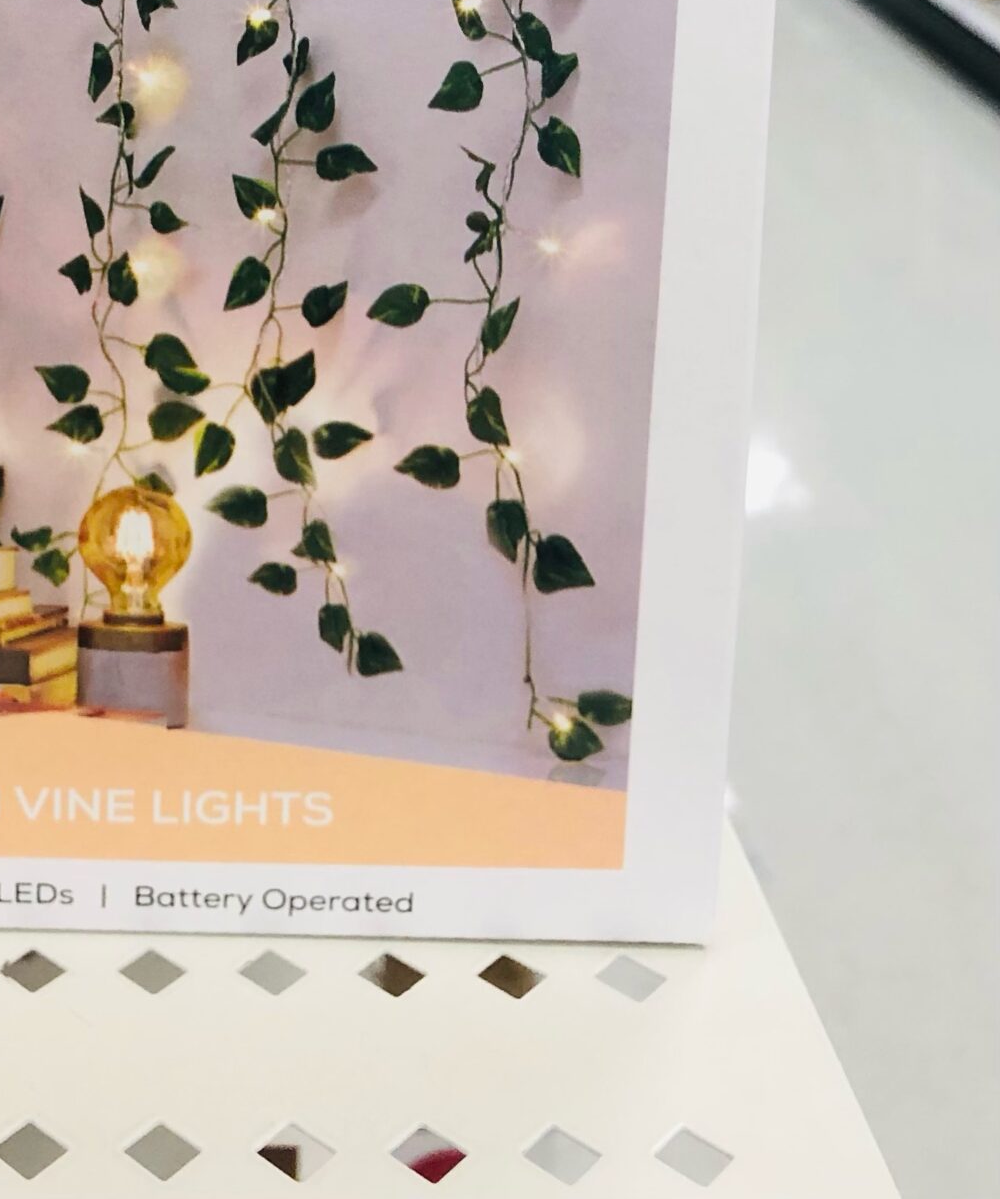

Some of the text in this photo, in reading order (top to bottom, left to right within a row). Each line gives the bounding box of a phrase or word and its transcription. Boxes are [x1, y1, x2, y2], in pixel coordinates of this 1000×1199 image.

[15, 786, 135, 823] VINE
[152, 789, 334, 828] LIGHTS
[135, 885, 253, 916] Battery
[262, 888, 414, 917] Operated
